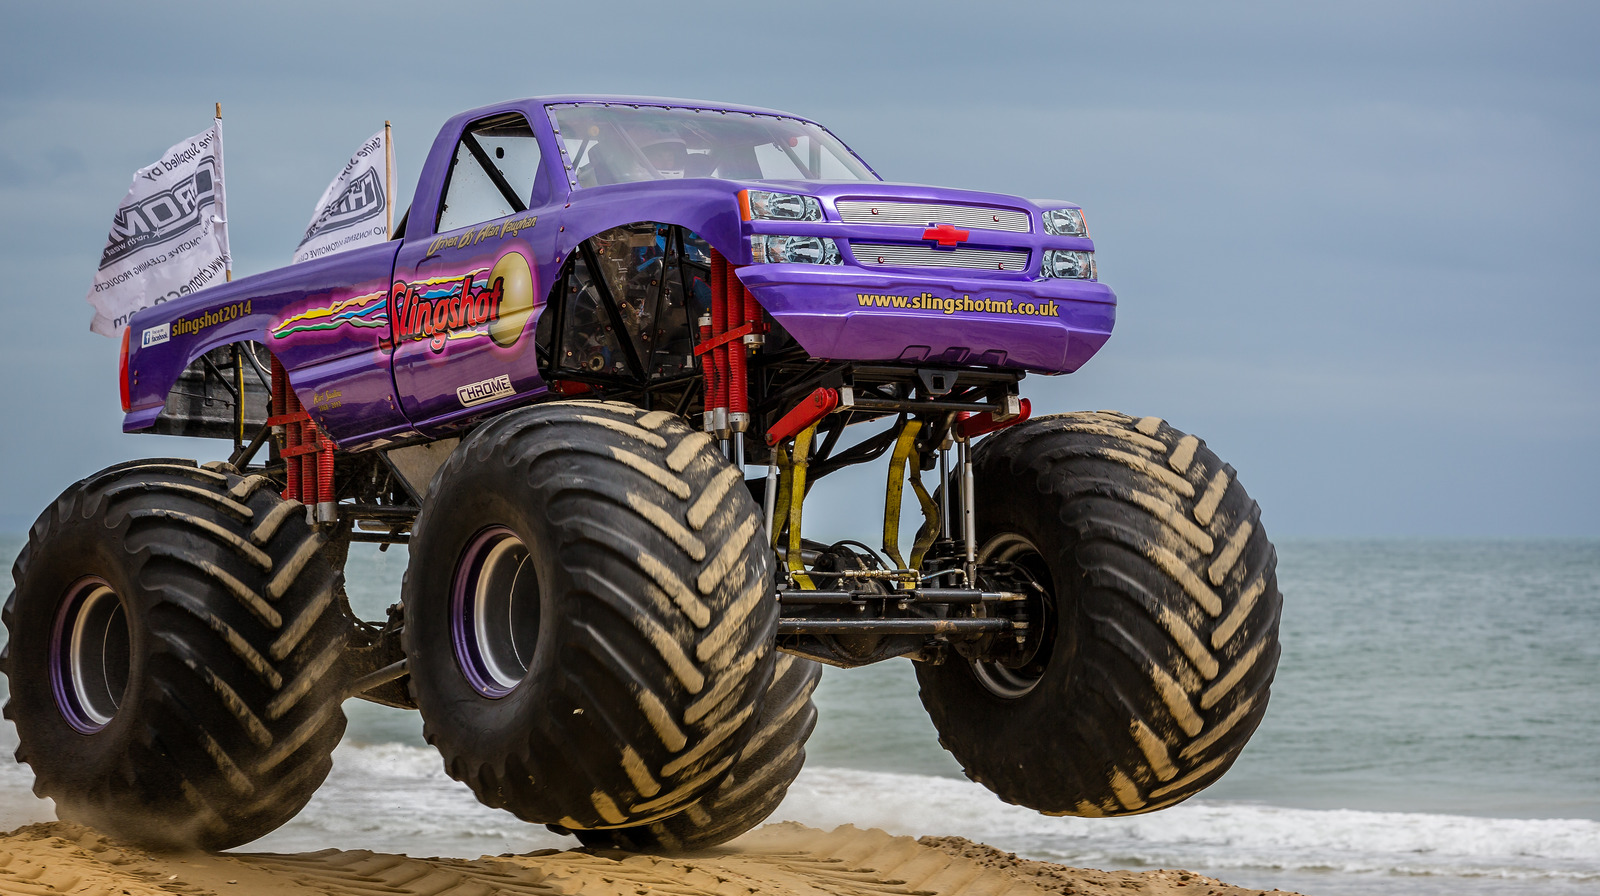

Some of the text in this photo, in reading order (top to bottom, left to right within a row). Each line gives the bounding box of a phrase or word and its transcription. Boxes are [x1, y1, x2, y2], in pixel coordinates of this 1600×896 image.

[426, 214, 538, 257] Driven By Alan Vaughan
[172, 299, 252, 336] slingshot2014
[379, 274, 504, 354] Slingshot
[857, 292, 1060, 317] www.slingshotmt.co.uk
[459, 377, 511, 403] CHROME
